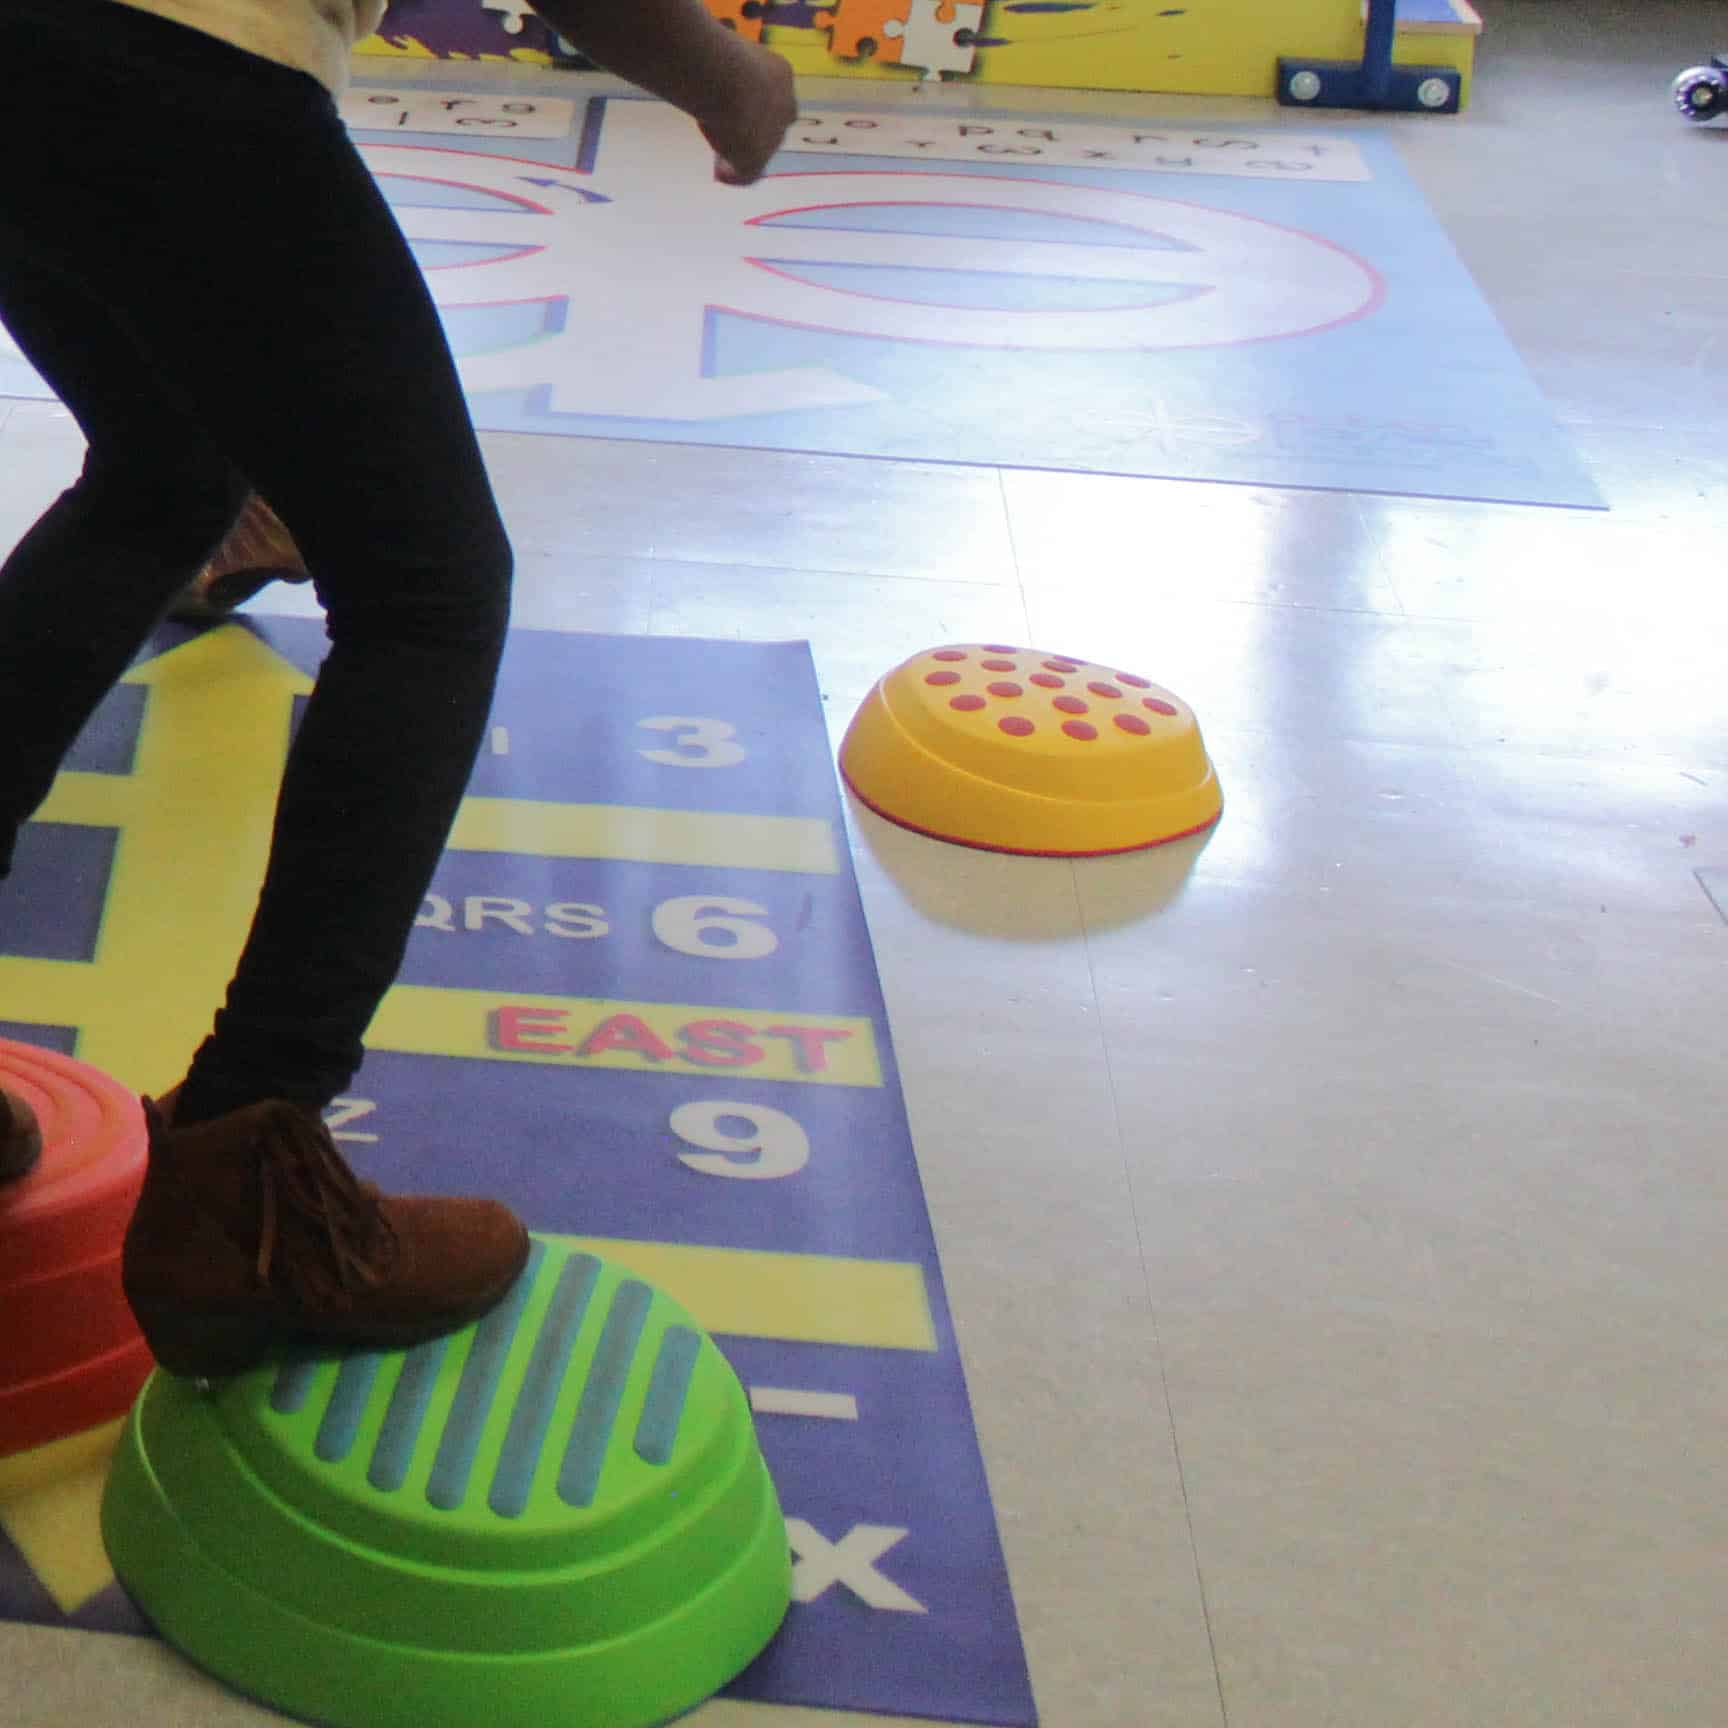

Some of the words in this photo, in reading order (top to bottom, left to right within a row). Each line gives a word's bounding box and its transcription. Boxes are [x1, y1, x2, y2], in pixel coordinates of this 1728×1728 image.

[636, 715, 745, 770] 3
[414, 894, 611, 941] QRS
[650, 894, 781, 961] 6
[482, 1004, 856, 1074] EAST
[668, 1099, 812, 1180] 9
